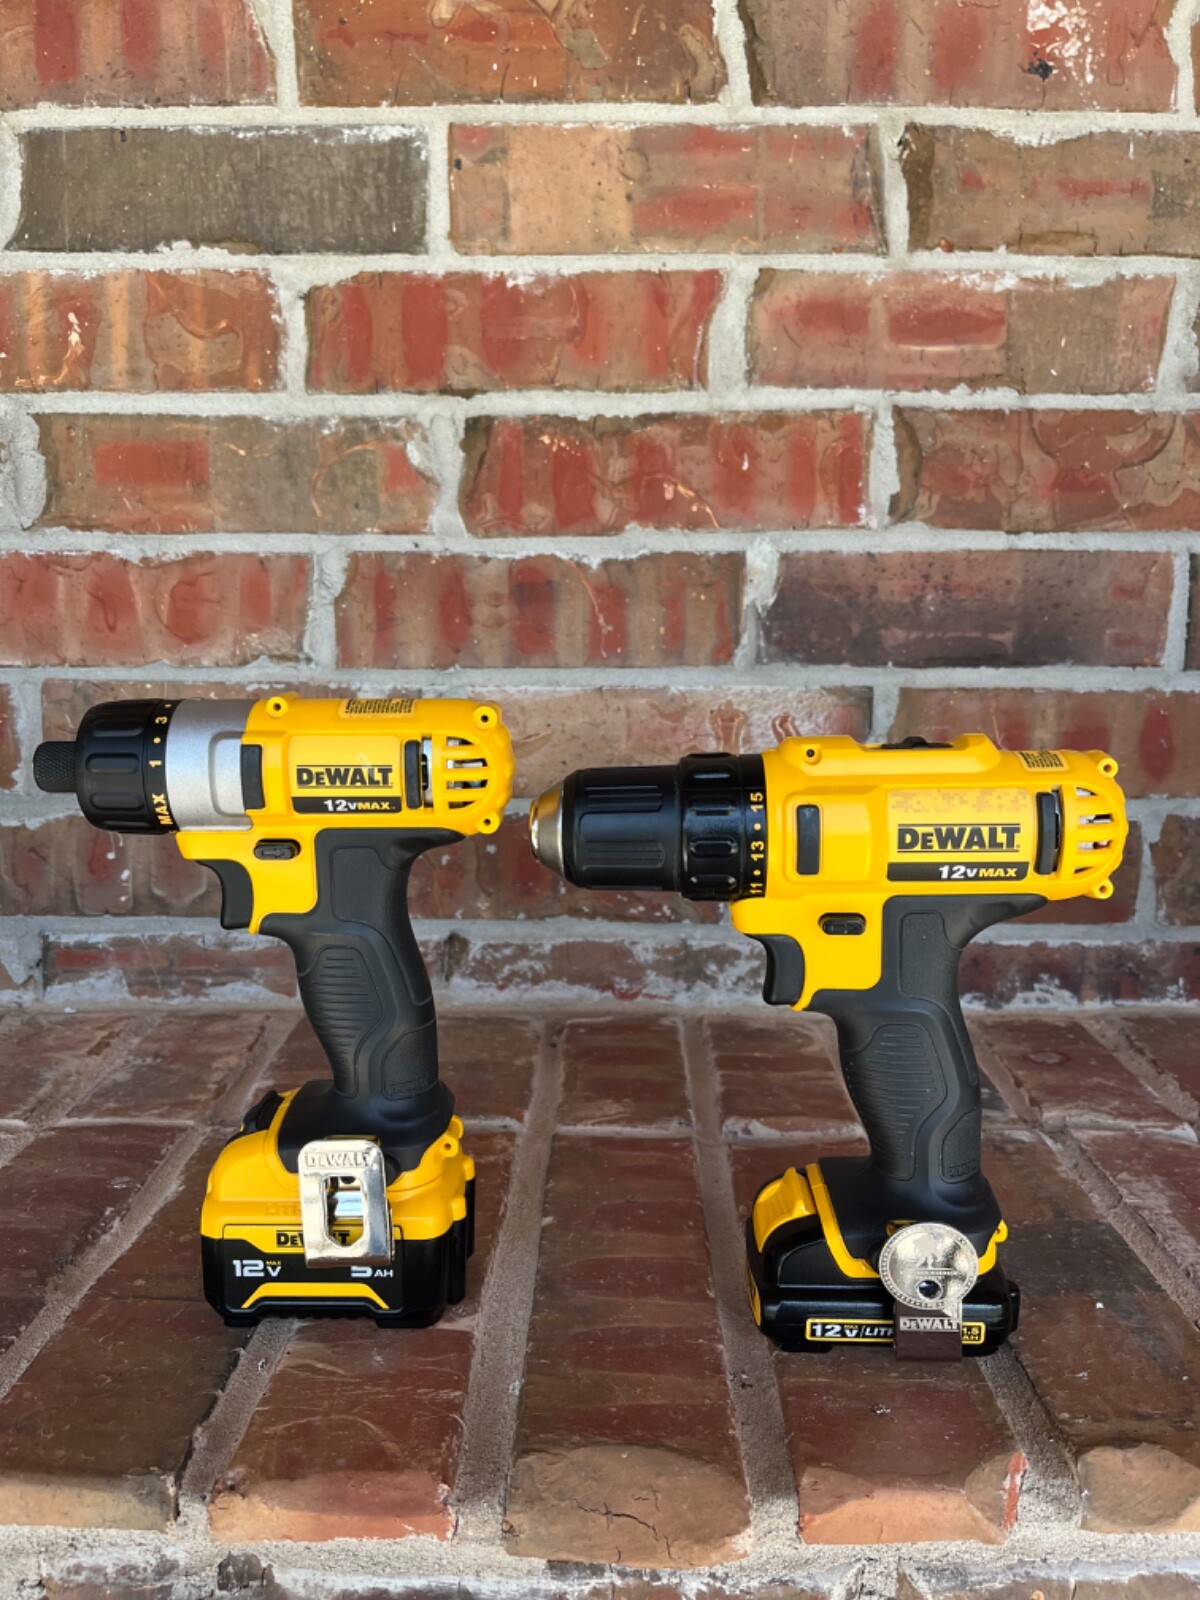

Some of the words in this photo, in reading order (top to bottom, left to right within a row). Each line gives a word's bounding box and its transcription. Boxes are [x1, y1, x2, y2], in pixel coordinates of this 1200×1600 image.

[155, 716, 168, 725] 3
[149, 760, 162, 768] 1
[152, 793, 173, 825] MAX
[750, 792, 764, 813] 15
[751, 841, 764, 862] 13
